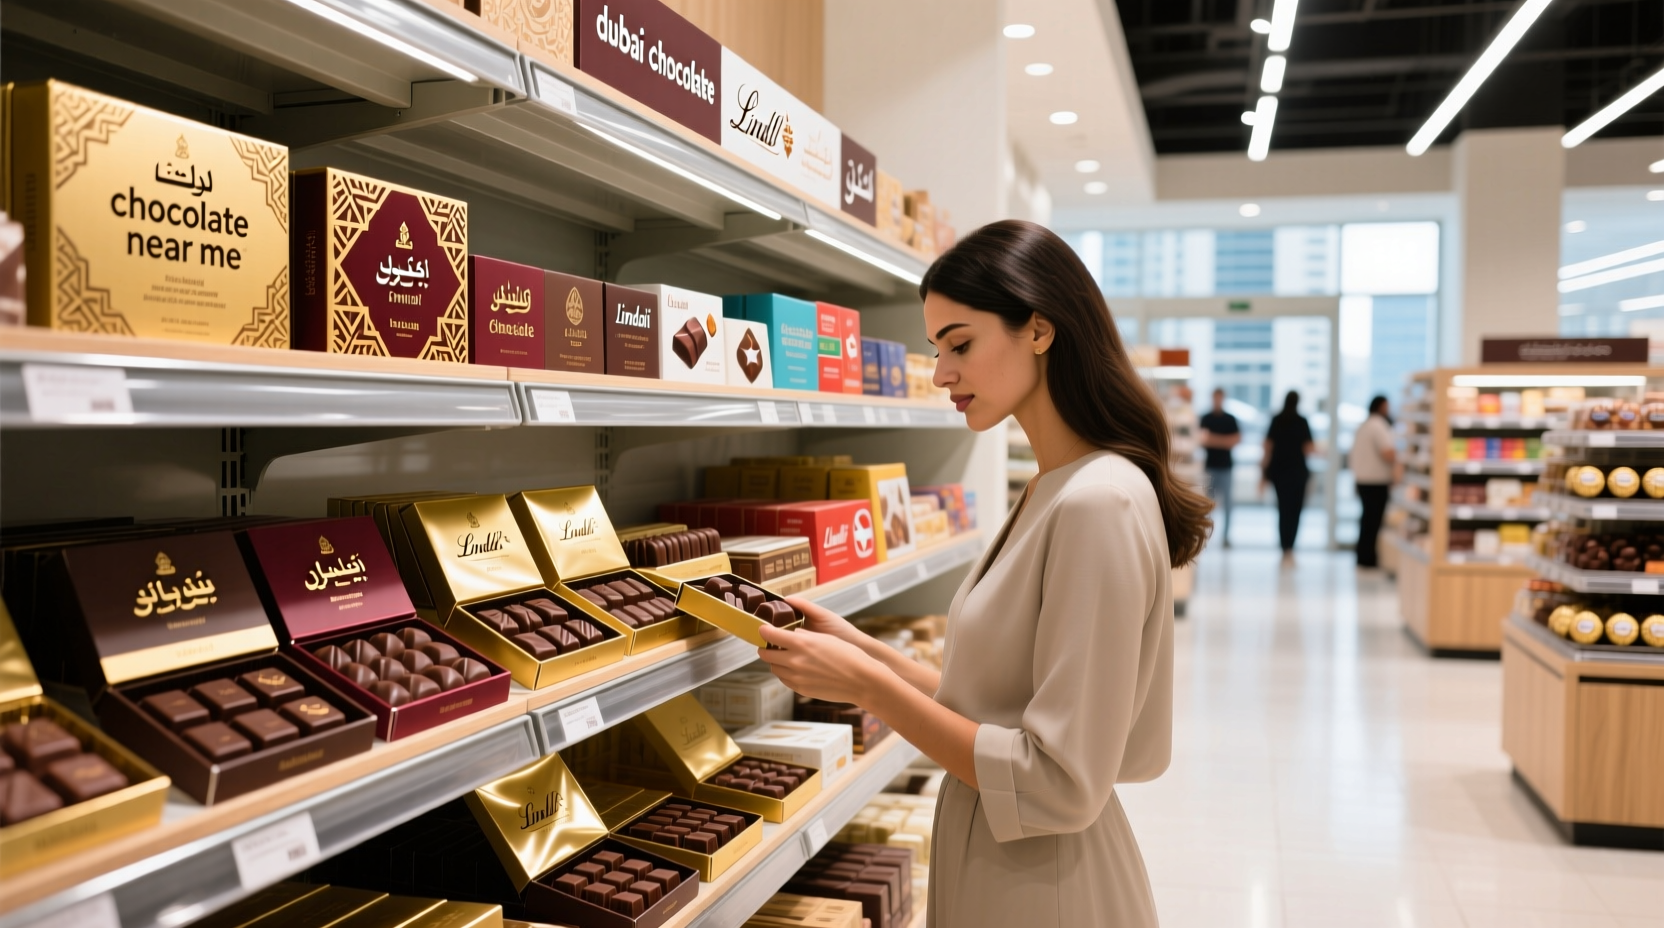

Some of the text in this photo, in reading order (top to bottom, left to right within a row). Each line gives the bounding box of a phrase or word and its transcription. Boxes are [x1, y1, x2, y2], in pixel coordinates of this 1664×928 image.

[596, 5, 715, 105] dubai chocolate
[110, 186, 249, 238] chocolate
[127, 231, 242, 270] near me
